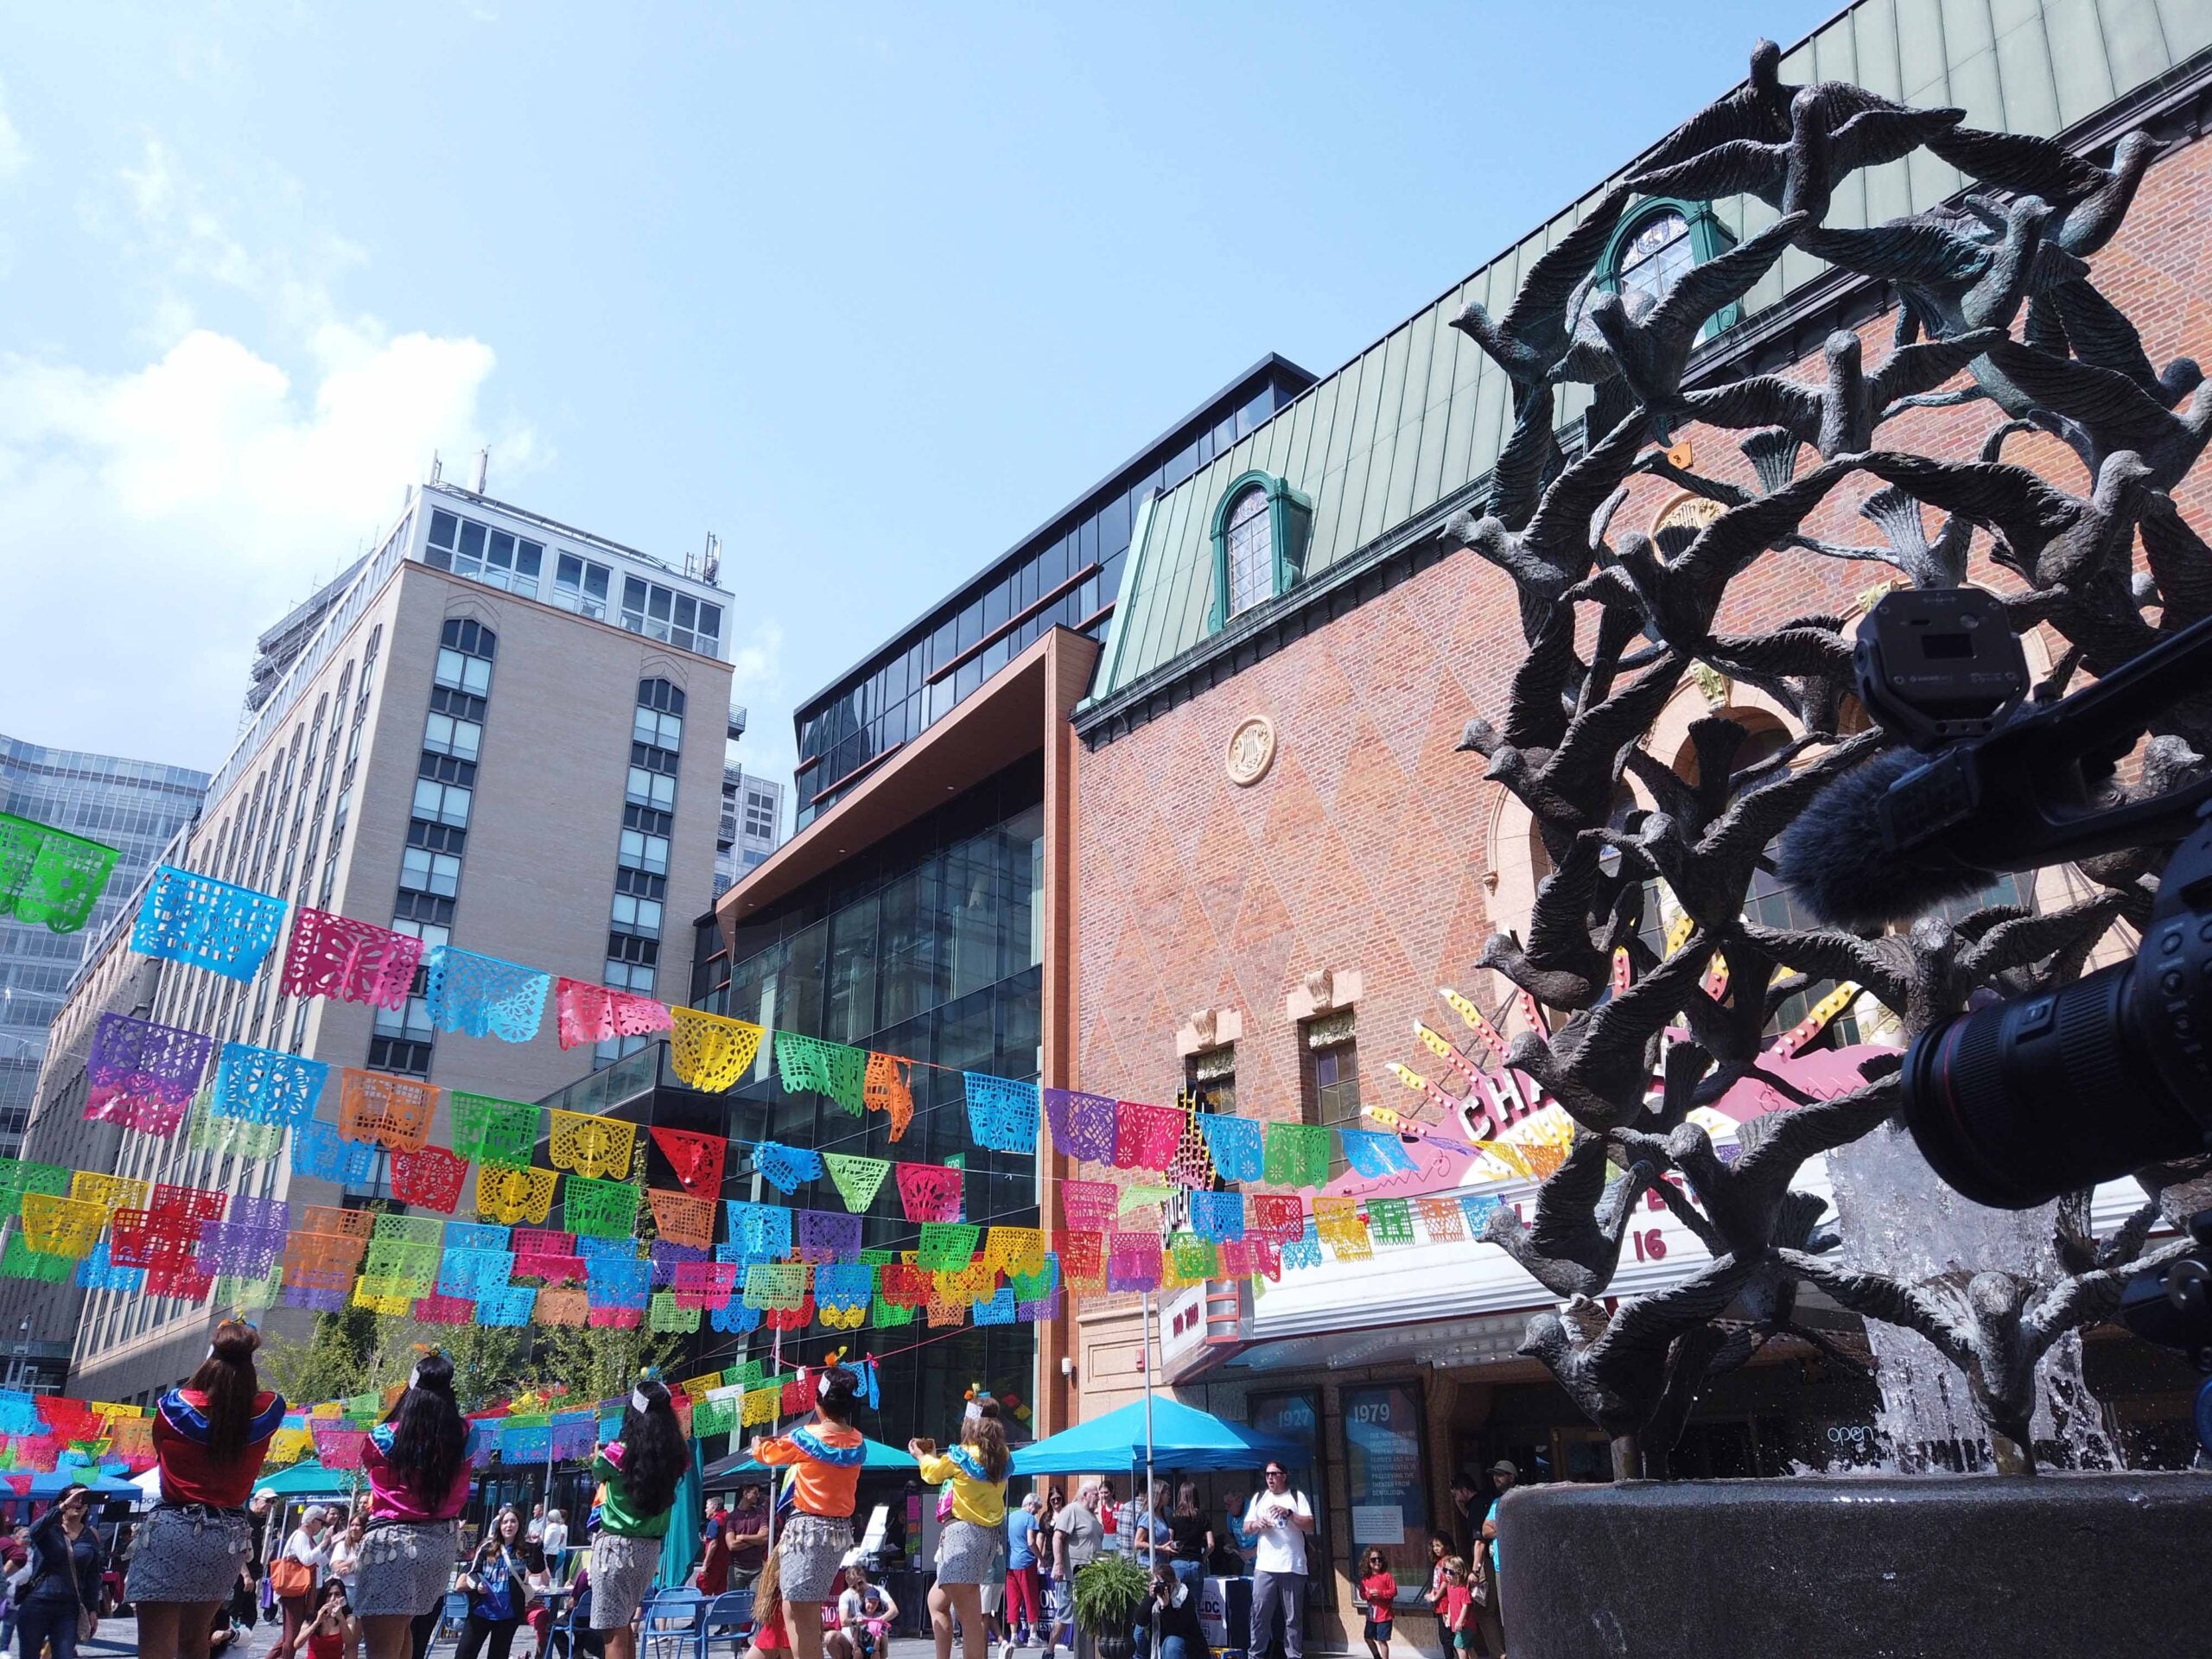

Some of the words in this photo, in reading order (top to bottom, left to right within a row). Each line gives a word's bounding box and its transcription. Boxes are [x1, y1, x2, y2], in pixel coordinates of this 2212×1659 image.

[1633, 1228, 1667, 1262] 16
[1279, 1409, 1310, 1427] 1927
[1354, 1403, 1390, 1423] 1979
[1827, 1426, 1874, 1446] open
